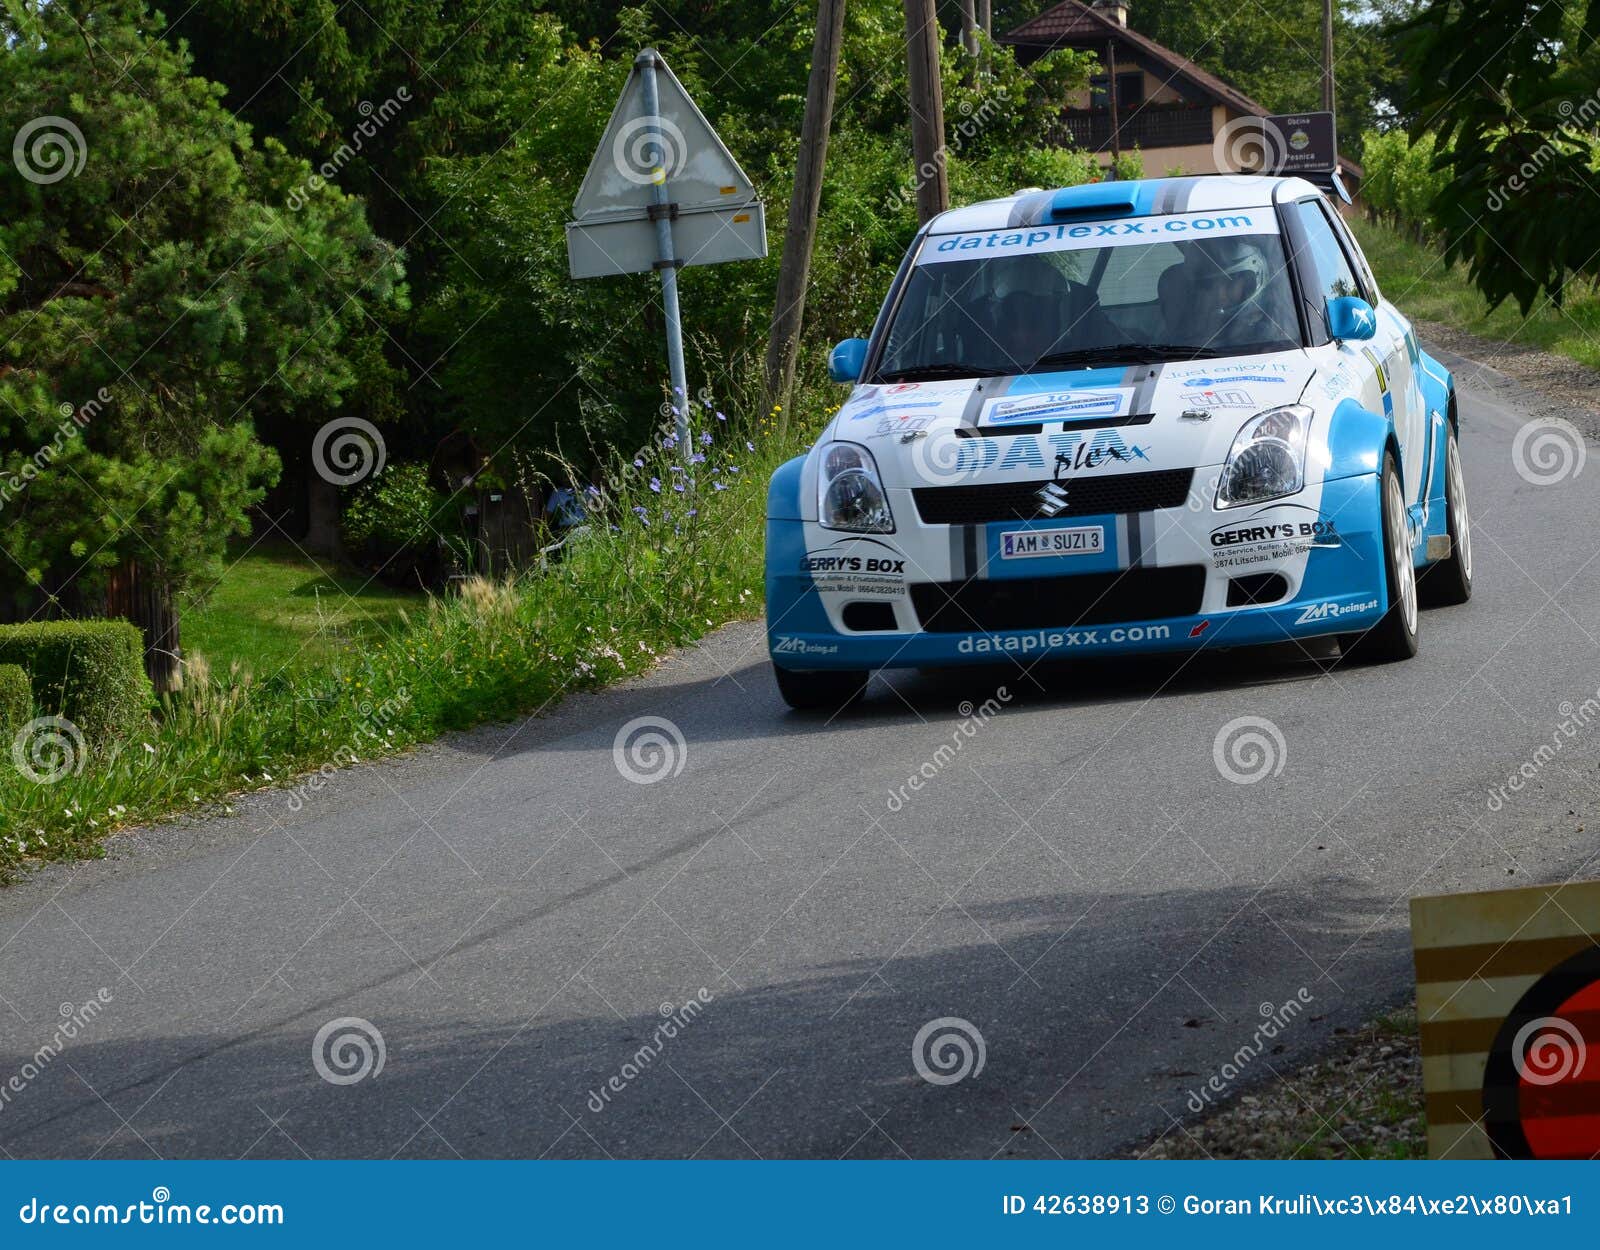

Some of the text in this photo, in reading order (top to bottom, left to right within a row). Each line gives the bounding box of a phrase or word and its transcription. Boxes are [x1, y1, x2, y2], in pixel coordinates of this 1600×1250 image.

[938, 215, 1253, 252] dataplexx.com
[956, 429, 1132, 472] DATA
[1016, 532, 1099, 552] AM SUZI 3
[1210, 523, 1294, 547] GERRY'S
[1299, 521, 1335, 536] BOX
[866, 559, 904, 573] BOX
[958, 624, 1170, 652] dataplexx.com
